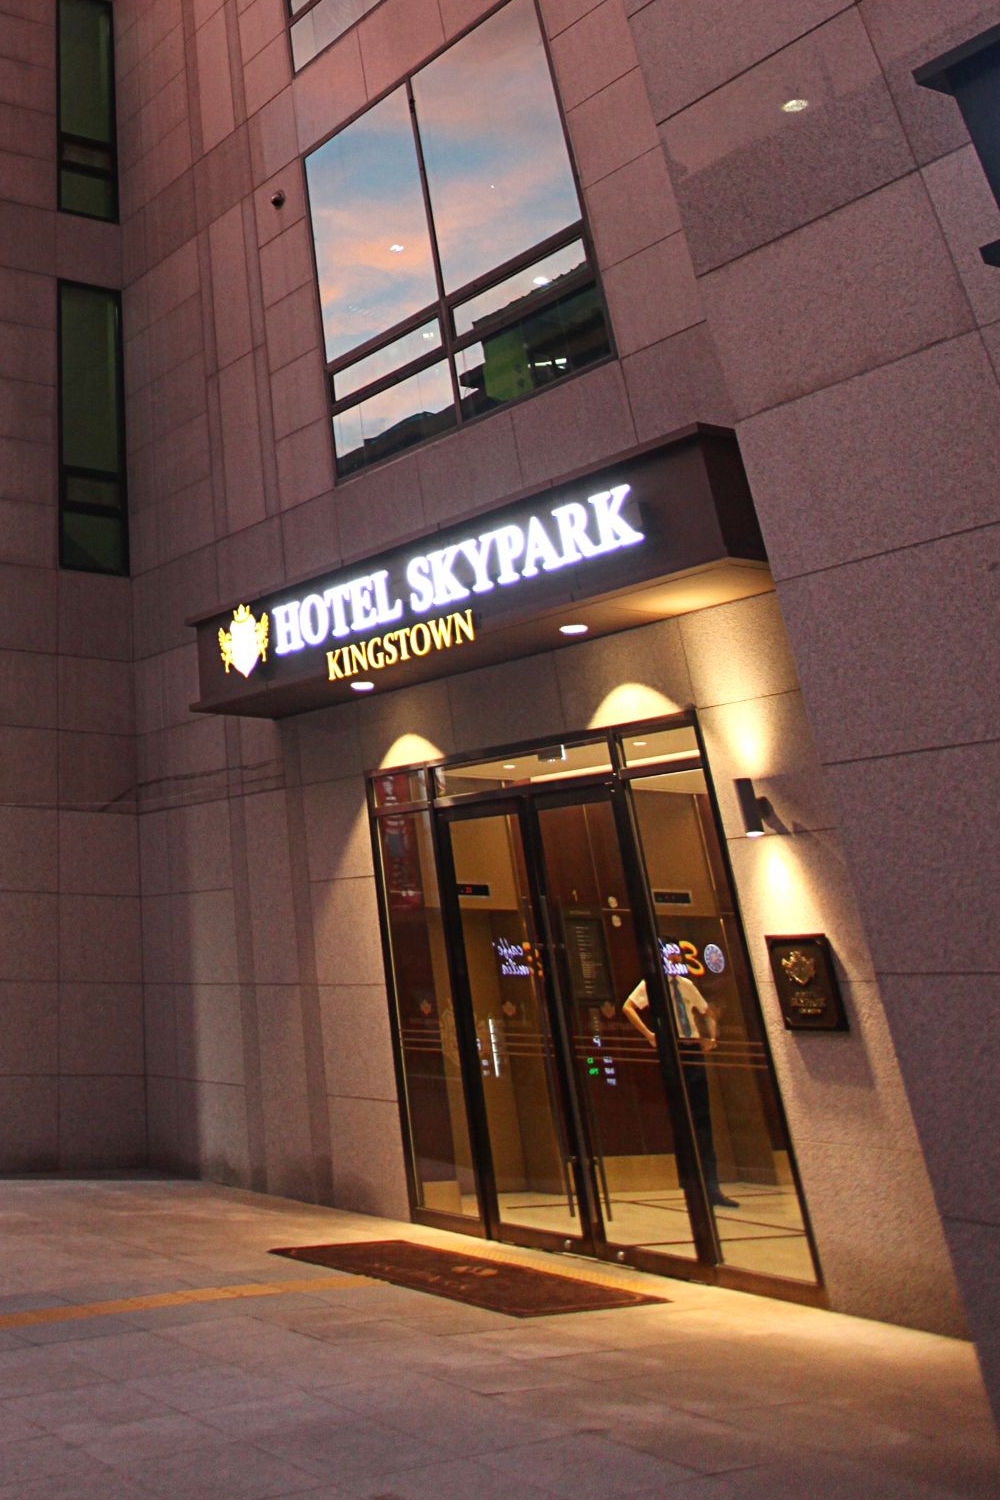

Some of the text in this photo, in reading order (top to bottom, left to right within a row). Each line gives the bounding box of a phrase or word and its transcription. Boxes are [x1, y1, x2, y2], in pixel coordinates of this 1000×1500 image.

[271, 483, 647, 656] HOTEL SKYPARK
[324, 608, 476, 681] KINGSTOWN
